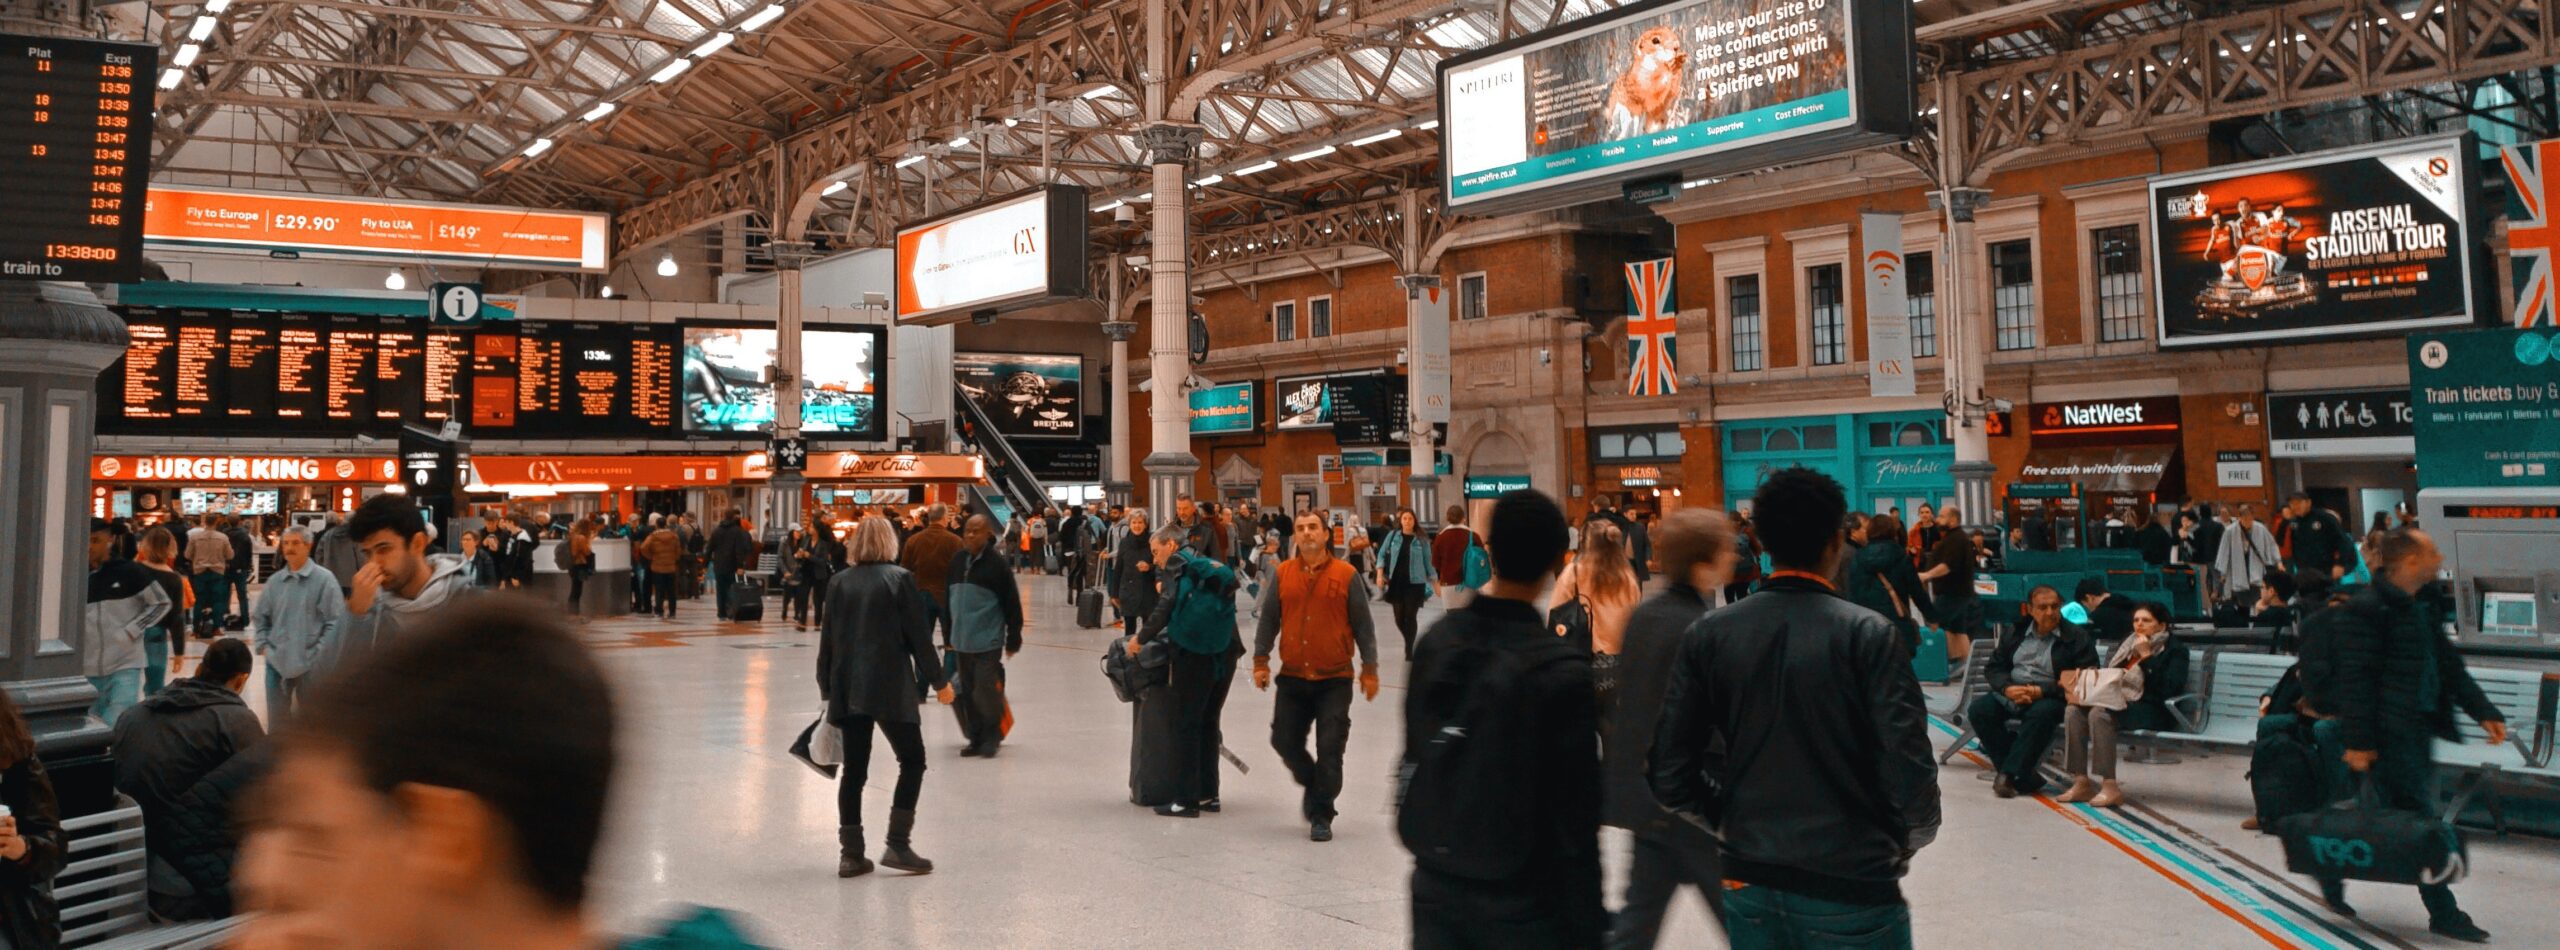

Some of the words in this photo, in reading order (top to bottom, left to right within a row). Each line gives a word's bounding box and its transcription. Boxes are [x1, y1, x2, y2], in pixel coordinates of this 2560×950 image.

[1695, 19, 1735, 43] Make
[1737, 8, 1772, 34] your
[1775, 0, 1804, 21] site
[1807, 0, 1825, 12] to
[1695, 44, 1722, 62] site
[1725, 18, 1817, 52] connections
[28, 47, 52, 59] Plat
[105, 53, 132, 69] Expt
[1696, 63, 1735, 81] more
[1738, 47, 1789, 71] secure
[1791, 34, 1828, 57] with
[38, 60, 51, 72] 11
[99, 82, 131, 94] 13:50
[1697, 87, 1707, 101] a
[1709, 74, 1763, 100] Spitfire
[1766, 61, 1799, 84] VPN
[35, 94, 50, 106] 18
[98, 99, 130, 111] 13:39
[34, 111, 48, 123] 18
[96, 115, 128, 127] 13:39
[95, 132, 127, 144] 13:47
[1461, 169, 1517, 187] www.spitfire.co.uk
[1546, 156, 1576, 169] Innovative
[1601, 146, 1625, 157] Flexible
[1652, 135, 1678, 147] Reliable
[1706, 120, 1744, 136] Supportive
[1775, 110, 1792, 121] Cost
[1792, 102, 1824, 117] Effective
[32, 145, 47, 156] 13
[94, 149, 125, 161] 13:45
[93, 165, 124, 177] 13:47
[92, 181, 123, 193] 14:06
[90, 198, 121, 210] 13:47
[2177, 201, 2193, 211] CUP
[89, 214, 120, 226] 14:06
[187, 207, 202, 220] Fly
[205, 209, 217, 219] to
[219, 208, 259, 222] Europe
[2329, 203, 2418, 235] ARSENAL
[361, 217, 376, 230] Fly
[379, 219, 391, 229] to
[392, 220, 414, 230] USA
[1013, 226, 1036, 256] GX
[2305, 229, 2389, 261] STADIUM
[2392, 223, 2447, 251] TOUR
[45, 244, 117, 261] 13:38:00
[2307, 260, 2321, 270] GET
[2322, 257, 2350, 269] CLOSER
[2351, 257, 2360, 266] TO
[2361, 255, 2375, 265] THE
[2376, 252, 2398, 263] HOME
[2398, 251, 2408, 261] OF
[2409, 247, 2447, 260] FOOTBALL
[3, 261, 41, 275] train
[45, 263, 62, 276] to
[2341, 287, 2417, 301] arsenal.com/tours
[1878, 360, 1902, 375] GX
[1285, 390, 1301, 408] ALEX
[1300, 382, 1321, 400] CROSS
[2424, 387, 2459, 404] Train
[2462, 384, 2513, 403] tickets
[2517, 383, 2542, 404] buy
[2548, 382, 2560, 400] &
[1427, 395, 1444, 407] GX
[1189, 408, 1199, 419] Try
[1199, 407, 1209, 417] the
[1210, 405, 1236, 416] Michelin
[1236, 403, 1249, 415] diet
[2064, 402, 2143, 426] NatWest
[2432, 412, 2455, 422] Billets
[2464, 411, 2503, 421] Fahrkarten
[1033, 420, 1074, 429] BREITLING
[2284, 441, 2309, 452] FREE
[2485, 451, 2502, 460] Cash
[2510, 450, 2526, 460] card
[135, 457, 249, 480] BURGER
[251, 457, 320, 480] KING
[528, 461, 564, 482] GX
[842, 458, 881, 476] Upper
[881, 456, 920, 472] Crust
[1876, 458, 1941, 484] Paperchase
[2022, 465, 2048, 476] Free
[2049, 464, 2079, 476] cash
[2082, 462, 2163, 476] withdrawals
[2228, 470, 2252, 481] FREE
[1470, 483, 1496, 492] CURRENCY
[1502, 482, 1529, 491] EXCHANGE
[2019, 498, 2042, 506] NatWest
[2113, 497, 2138, 505] NatWest
[2530, 506, 2558, 519] are
